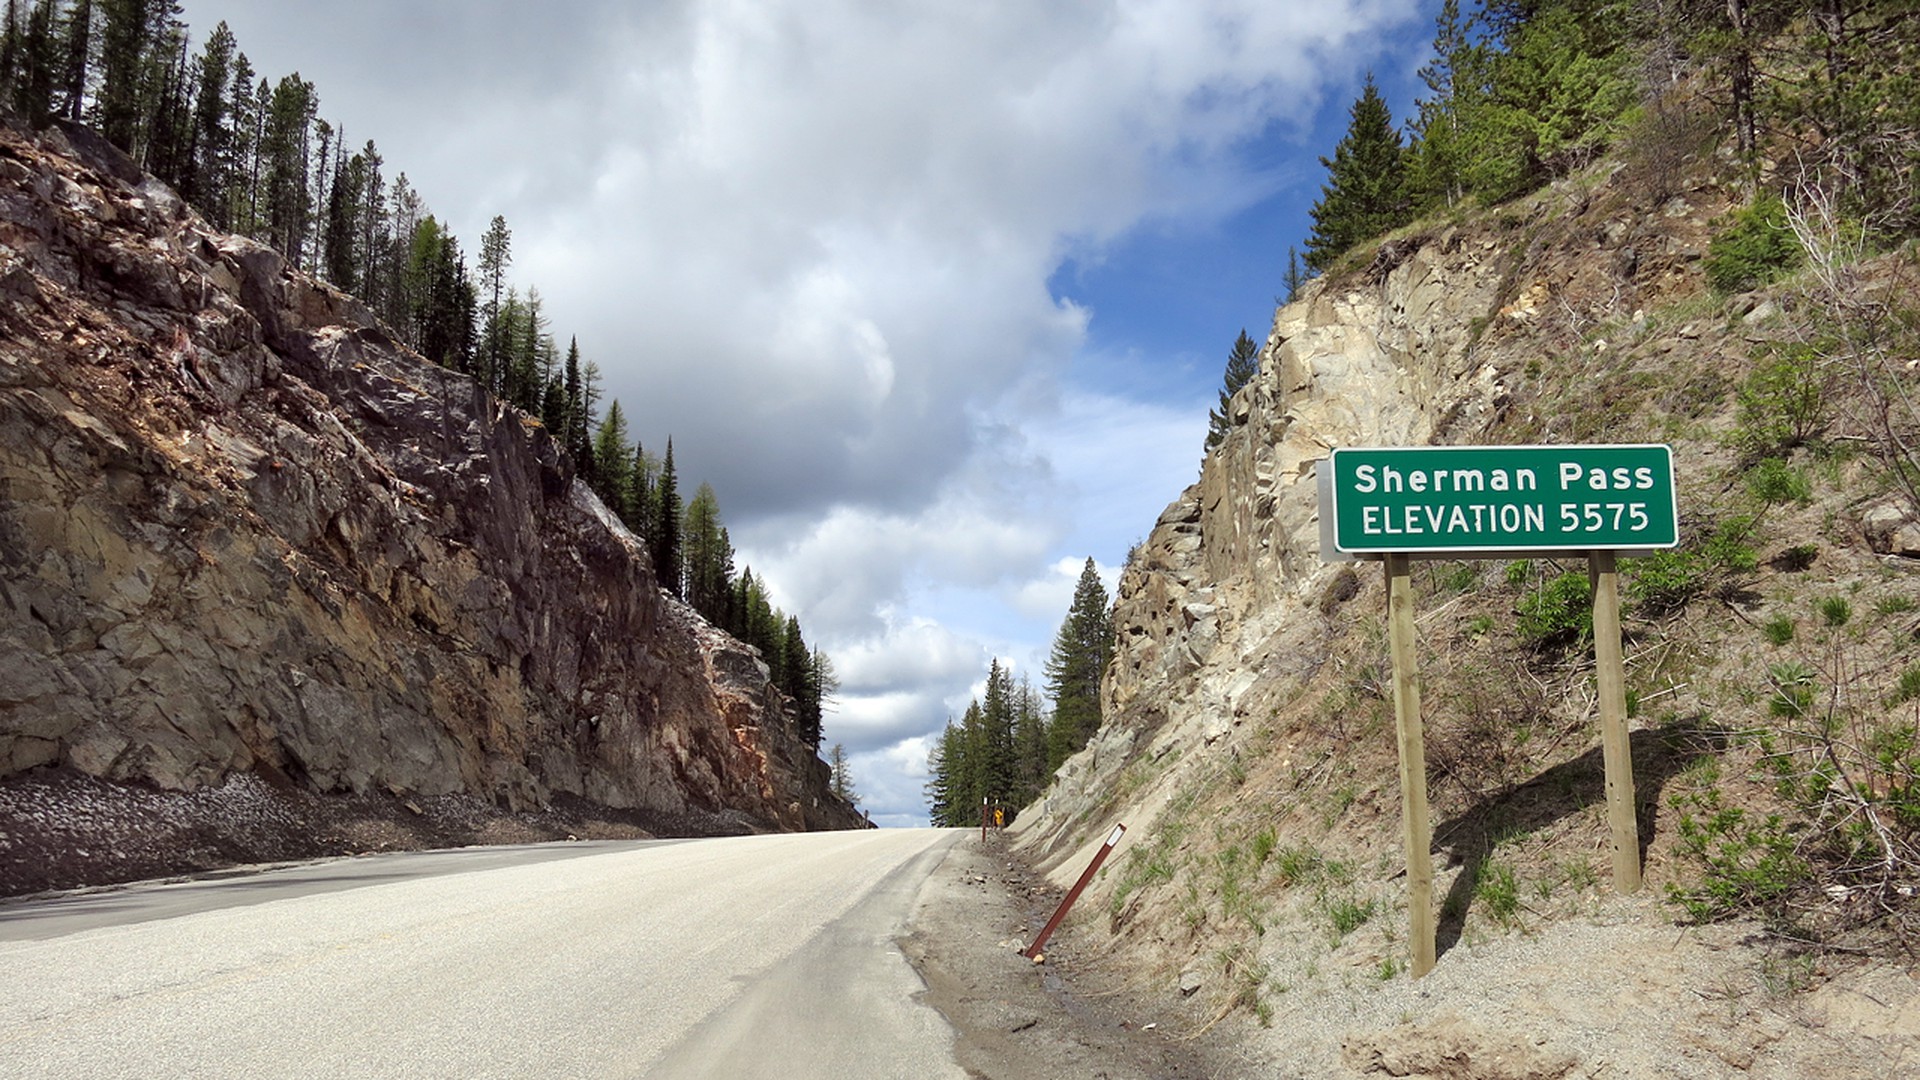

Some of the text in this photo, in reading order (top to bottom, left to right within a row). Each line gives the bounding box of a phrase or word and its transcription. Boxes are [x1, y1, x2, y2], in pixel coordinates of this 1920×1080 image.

[1354, 462, 1654, 493] Sherman Pass
[1362, 503, 1649, 534] ELEVATION 5575
